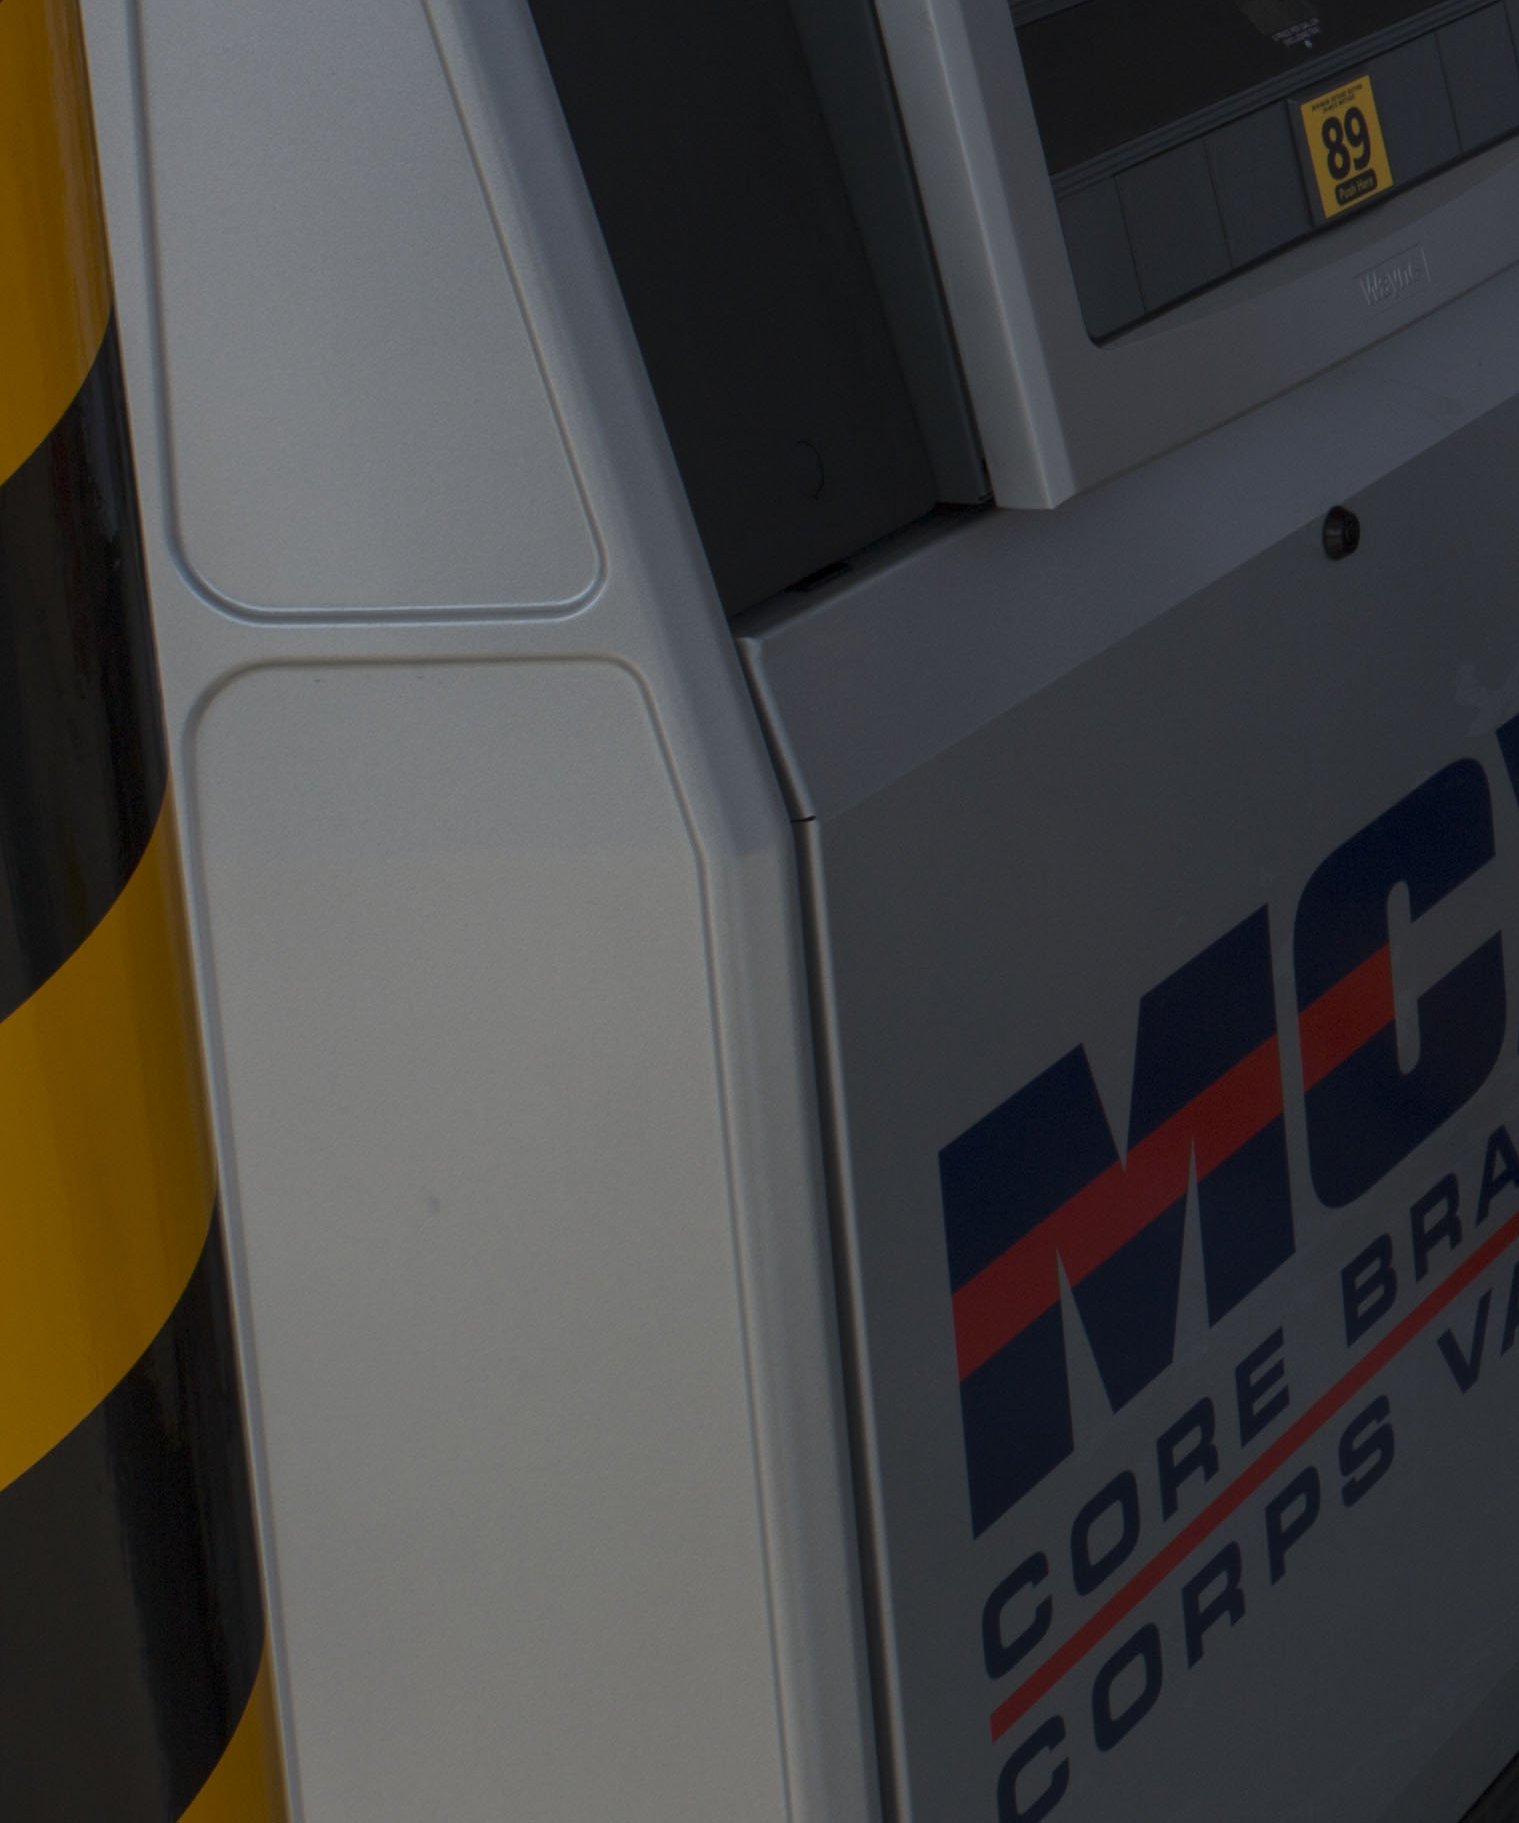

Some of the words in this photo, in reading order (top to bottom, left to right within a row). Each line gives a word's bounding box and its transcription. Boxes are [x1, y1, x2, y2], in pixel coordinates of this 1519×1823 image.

[1322, 107, 1372, 180] 89
[1336, 184, 1358, 203] Push
[1356, 175, 1376, 192] Here
[983, 1327, 1291, 1681] CORE
[996, 1396, 1396, 1823] CORPS
